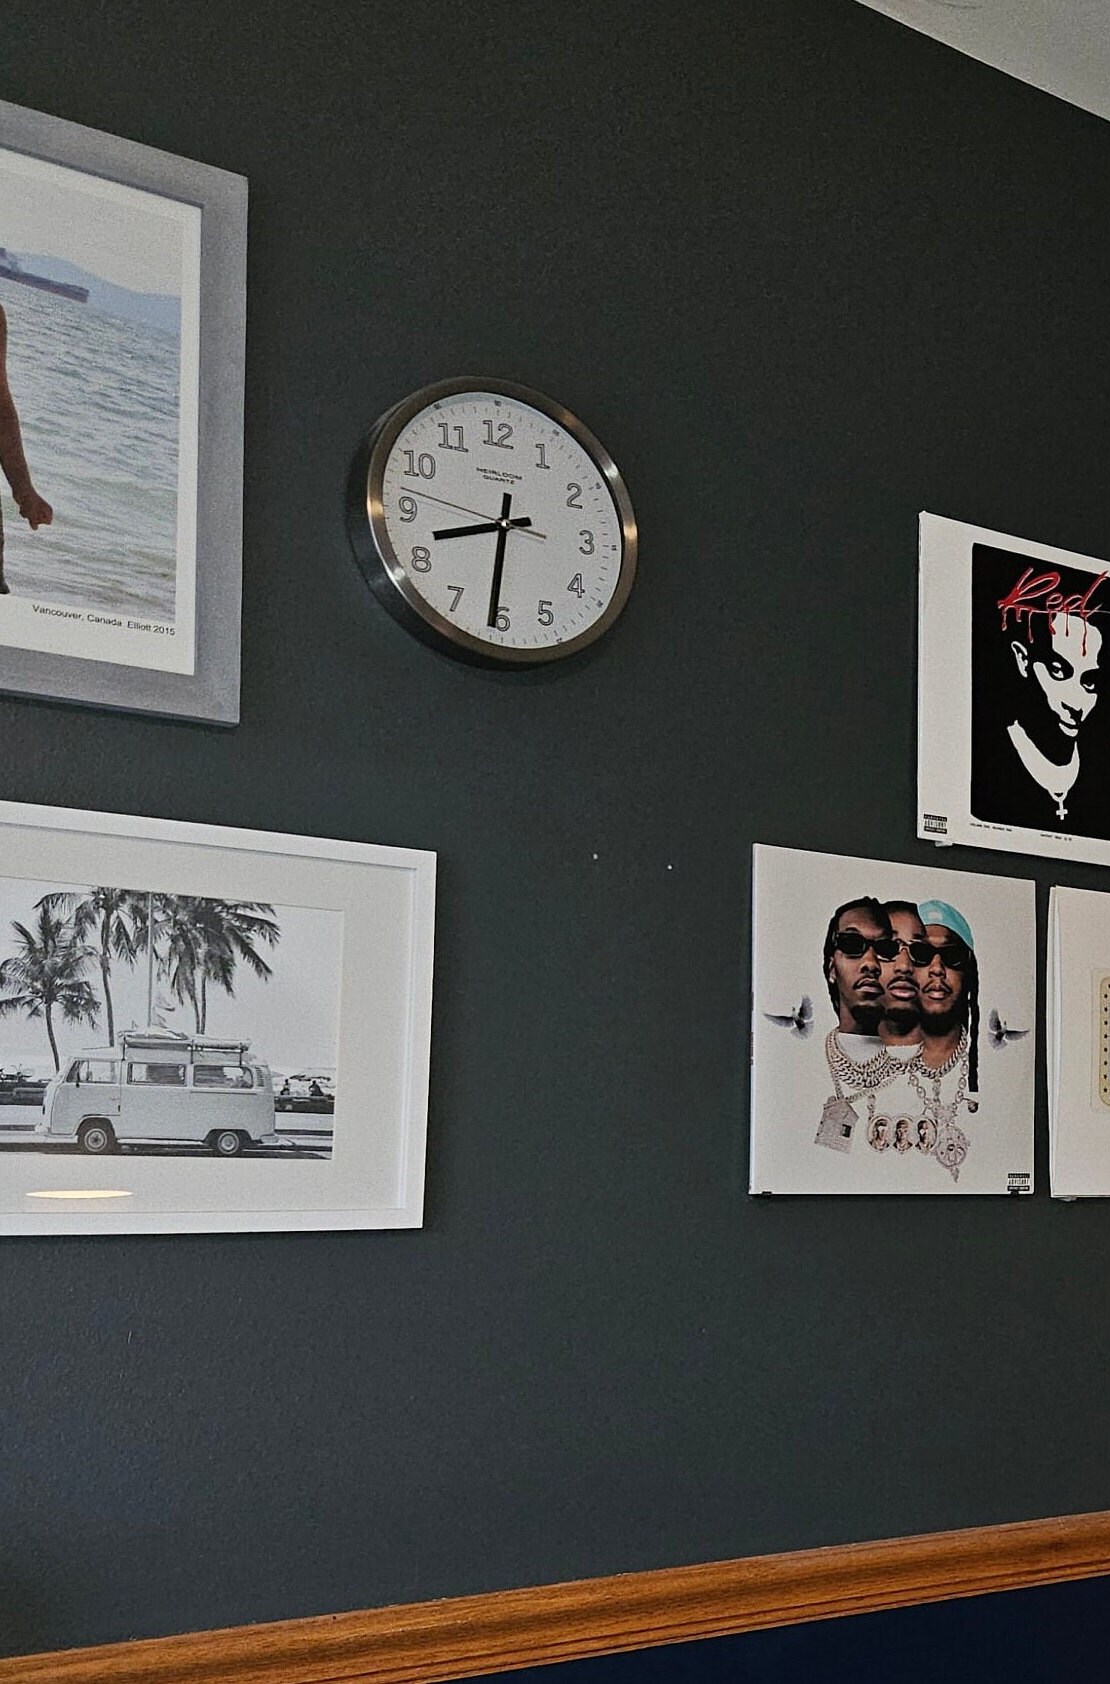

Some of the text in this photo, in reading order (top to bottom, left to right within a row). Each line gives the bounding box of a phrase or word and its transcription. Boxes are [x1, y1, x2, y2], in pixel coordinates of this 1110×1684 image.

[437, 422, 468, 452] 11
[483, 419, 514, 450] 12
[403, 450, 436, 479] 10
[535, 443, 550, 470] 1
[566, 482, 583, 509] 2
[398, 496, 418, 523] 9
[579, 530, 595, 555] 3
[411, 546, 432, 573] 8
[447, 585, 465, 612] 7
[567, 573, 585, 598] 4
[32, 604, 176, 637] Vancouver, Canada Elliott 2015
[495, 606, 511, 632] 6
[537, 600, 554, 626] 5
